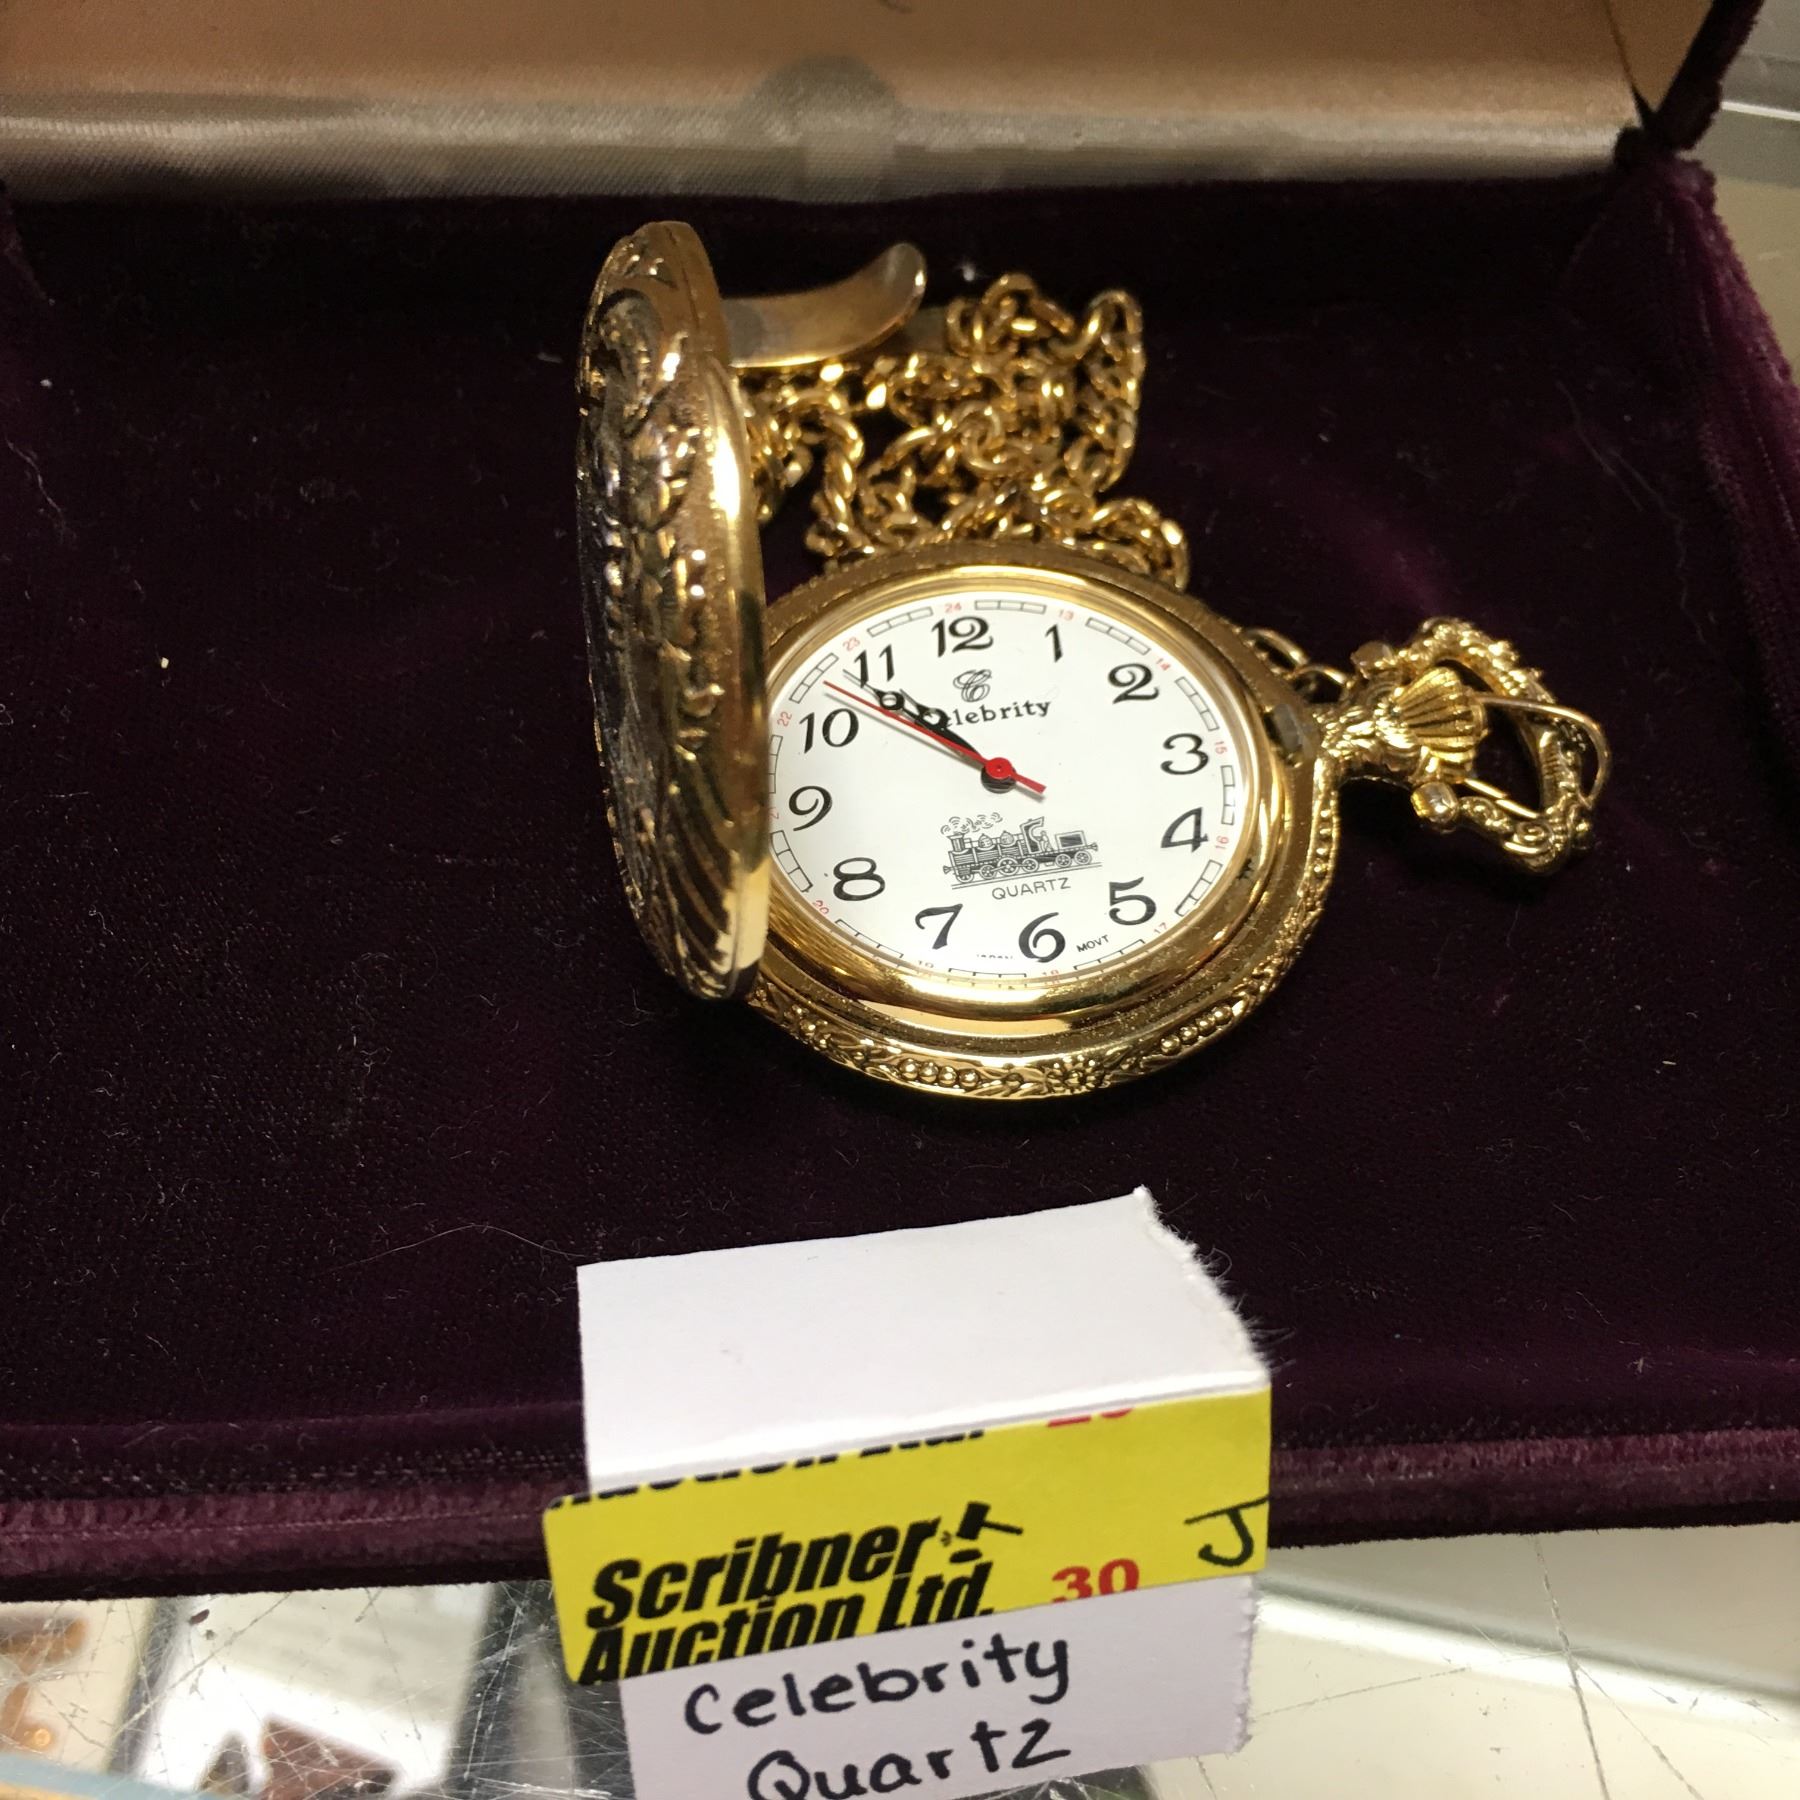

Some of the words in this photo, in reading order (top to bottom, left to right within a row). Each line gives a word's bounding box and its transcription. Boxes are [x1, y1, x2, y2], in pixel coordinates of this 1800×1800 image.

[945, 602, 962, 613] 24
[1058, 609, 1074, 621] 13
[843, 637, 861, 651] 23
[931, 616, 994, 658] 12
[1044, 623, 1064, 663] 1
[854, 644, 895, 688] 11
[1107, 662, 1160, 704] 2
[1155, 657, 1171, 671] 14
[777, 711, 793, 727] 22
[799, 708, 859, 754] 10
[945, 700, 1051, 727] lebrity
[1160, 733, 1209, 775] 3
[1214, 740, 1228, 755] 15
[788, 785, 833, 831] 9
[1160, 806, 1210, 853] 4
[1214, 835, 1230, 851] 16
[833, 857, 886, 901] 8
[991, 877, 1072, 900] QUARTZ
[813, 899, 830, 915] 20
[1108, 876, 1157, 926] 5
[915, 903, 963, 950] 7
[1018, 912, 1066, 963] 6
[1076, 934, 1111, 953] MOVT
[1153, 922, 1168, 935] 17
[1184, 1494, 1269, 1568] J
[586, 1517, 941, 1629] Scribner
[1051, 1558, 1139, 1604] 30
[578, 1593, 866, 1685] Auction
[876, 1561, 994, 1633] Ltd.
[684, 1633, 1068, 1735] Celebrity
[747, 1718, 1071, 1800] Quartz
